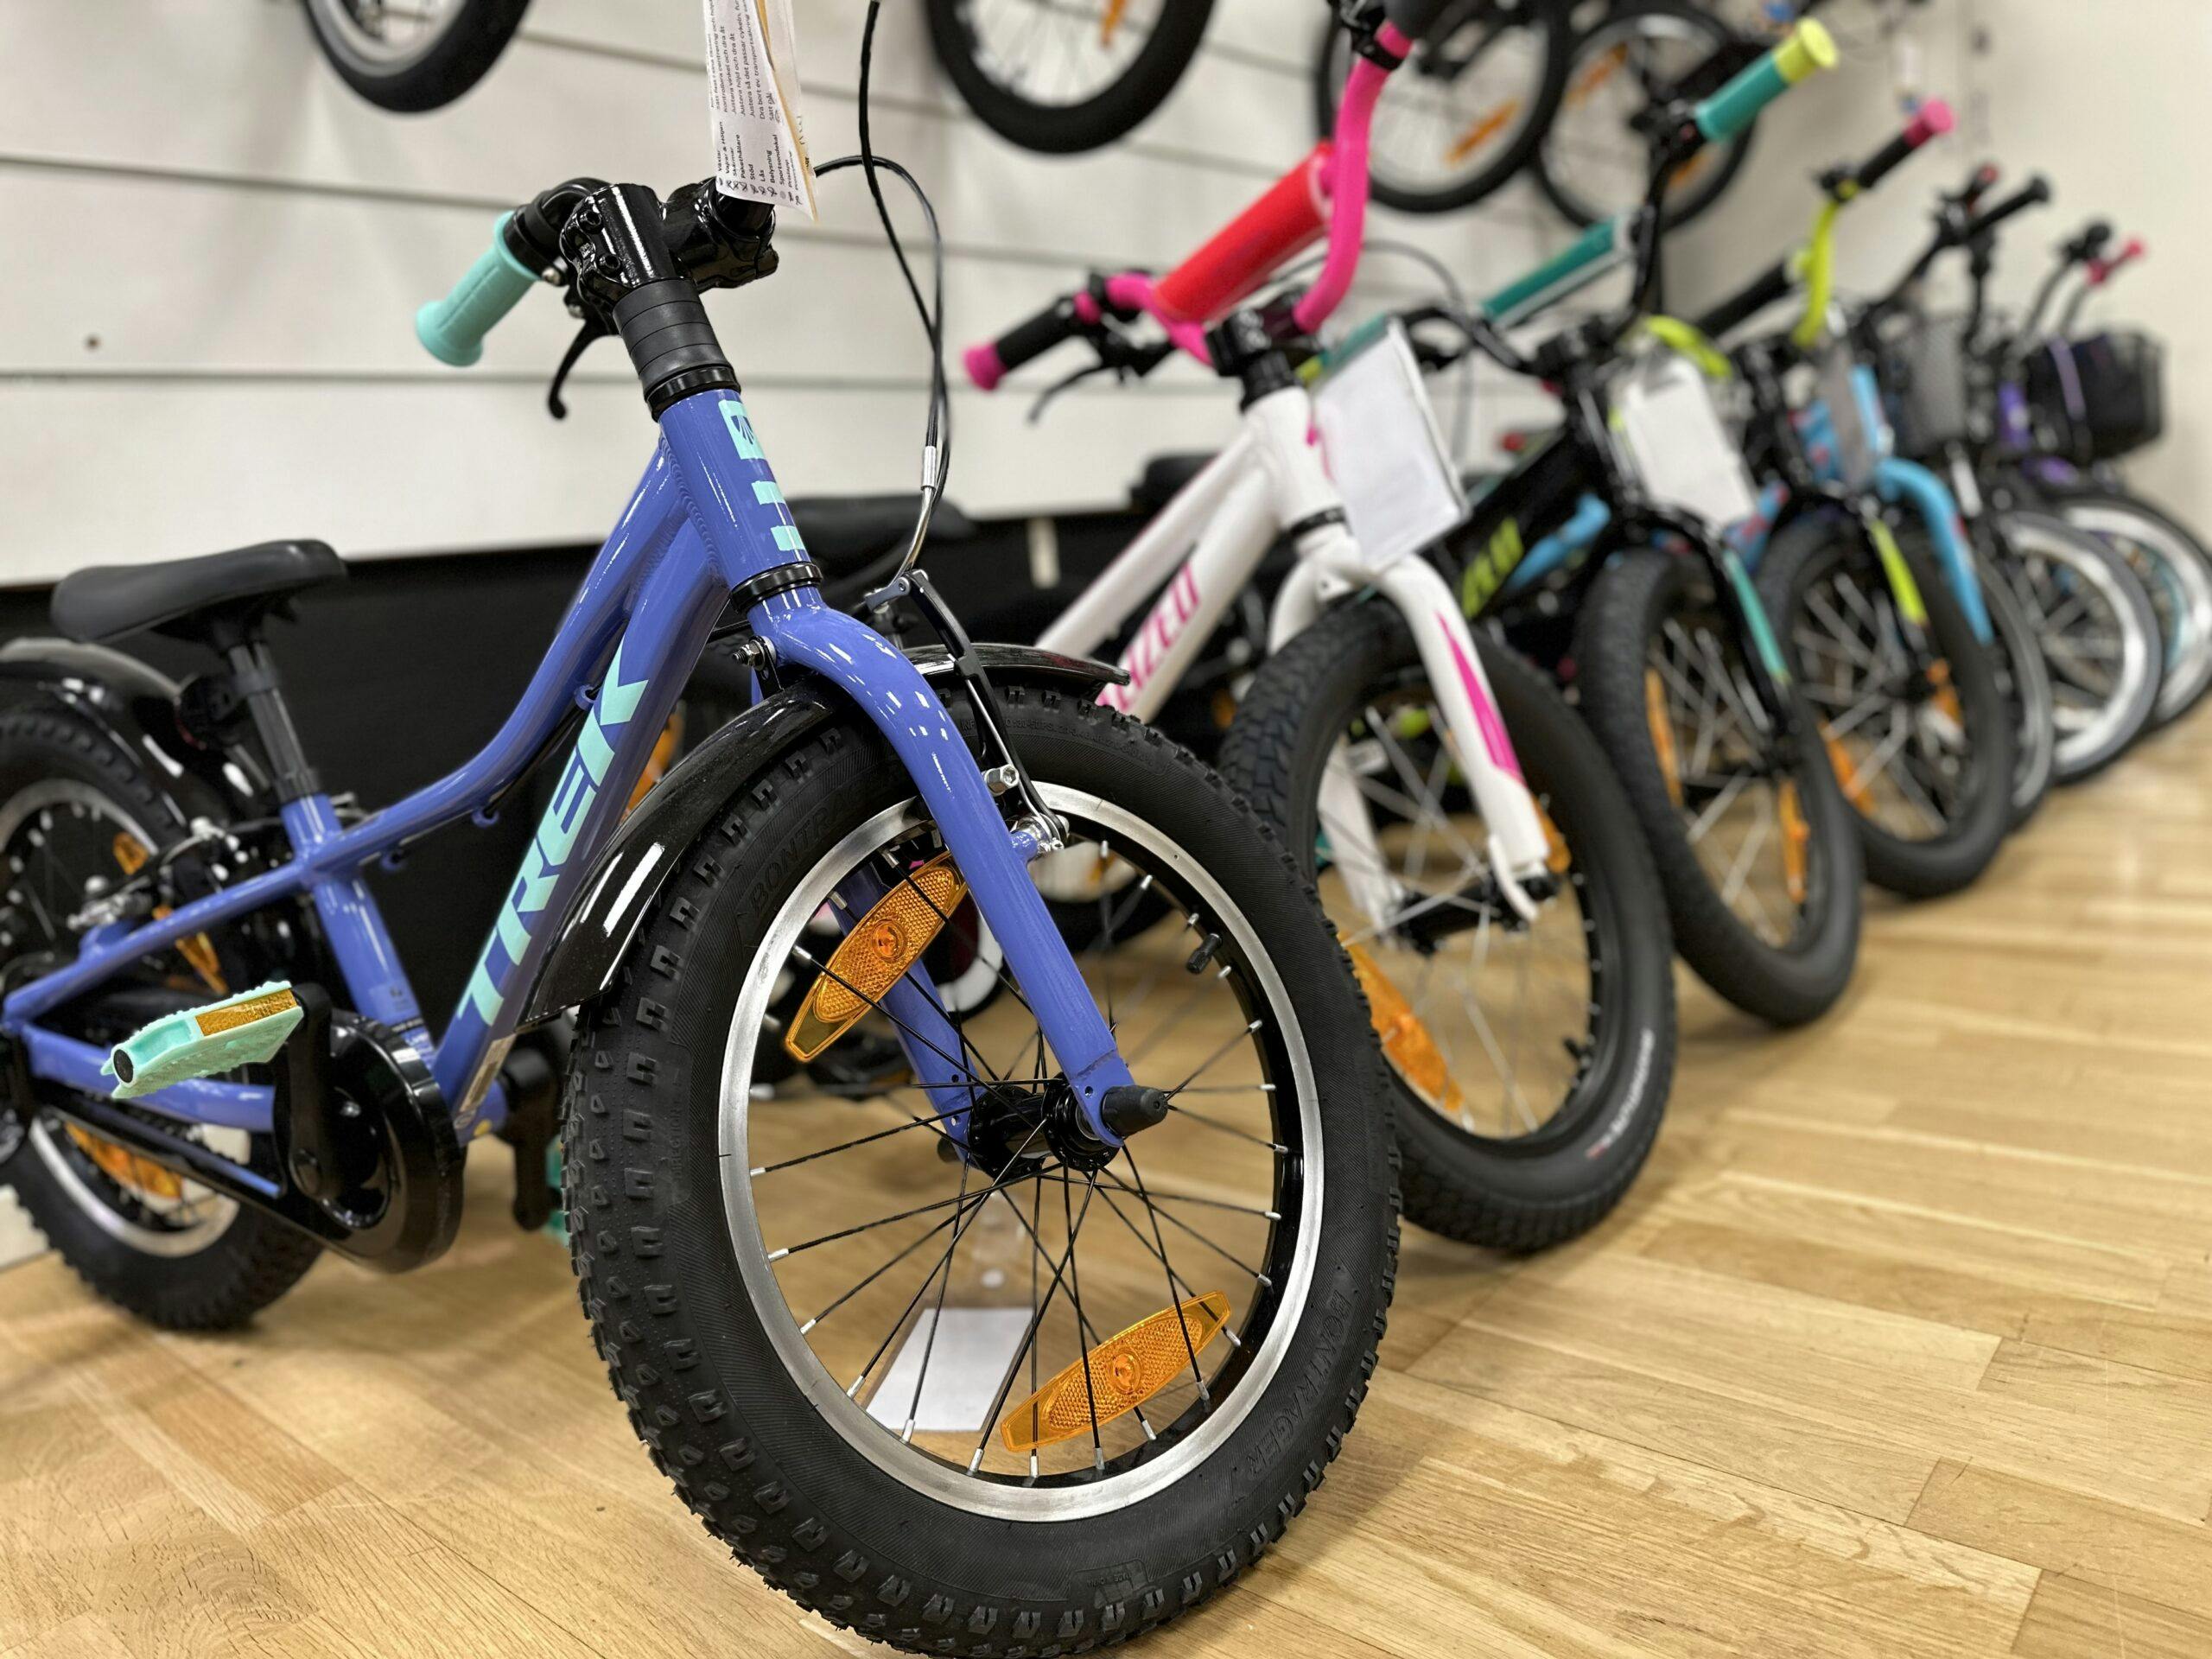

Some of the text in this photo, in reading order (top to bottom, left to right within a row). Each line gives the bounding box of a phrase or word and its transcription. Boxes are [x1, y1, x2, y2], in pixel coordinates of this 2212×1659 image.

[741, 41, 750, 66] passar
[766, 149, 775, 183] Belysning
[457, 633, 649, 1027] TREK
[1245, 1288, 1353, 1476] BONTRAGER
